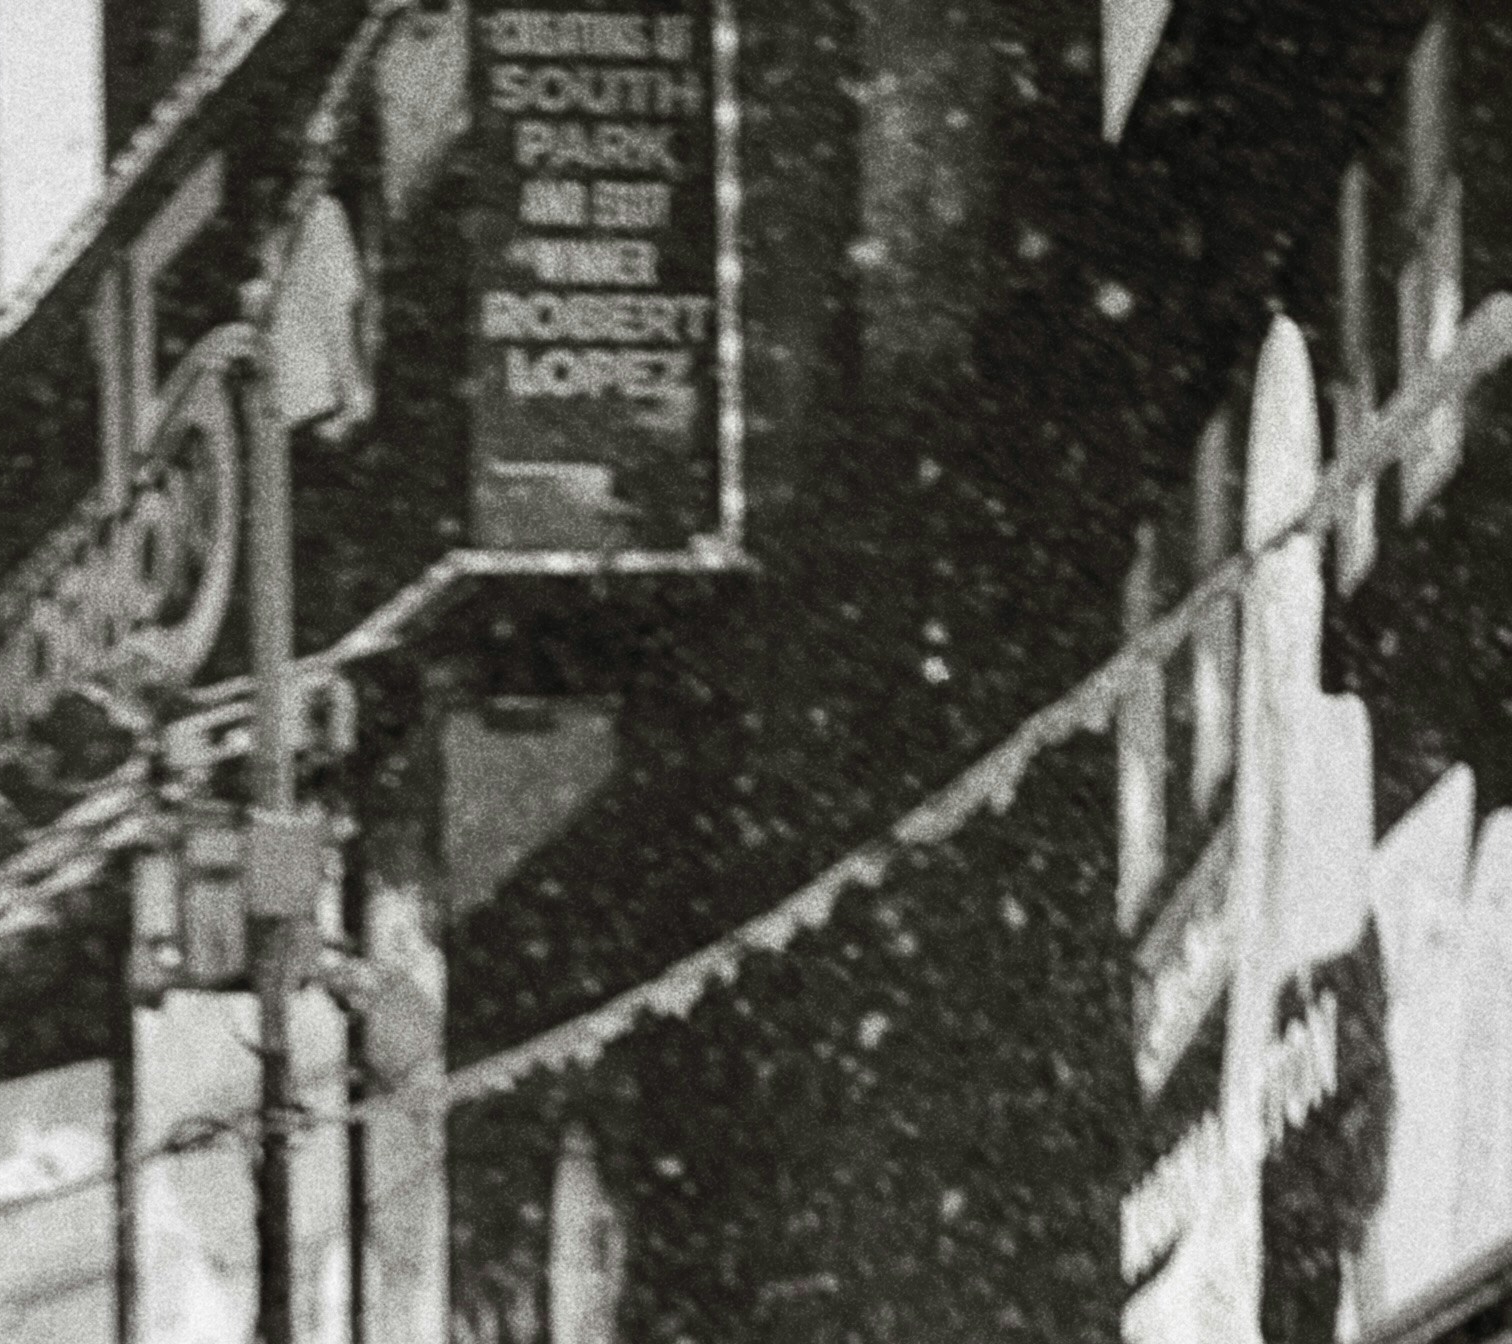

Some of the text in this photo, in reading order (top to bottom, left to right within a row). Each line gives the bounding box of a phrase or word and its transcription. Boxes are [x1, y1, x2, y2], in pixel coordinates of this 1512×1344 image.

[490, 64, 702, 113] SOUTH
[514, 119, 678, 171] PARK
[481, 291, 710, 342] ROBERT
[504, 348, 690, 402] LOPEZ
